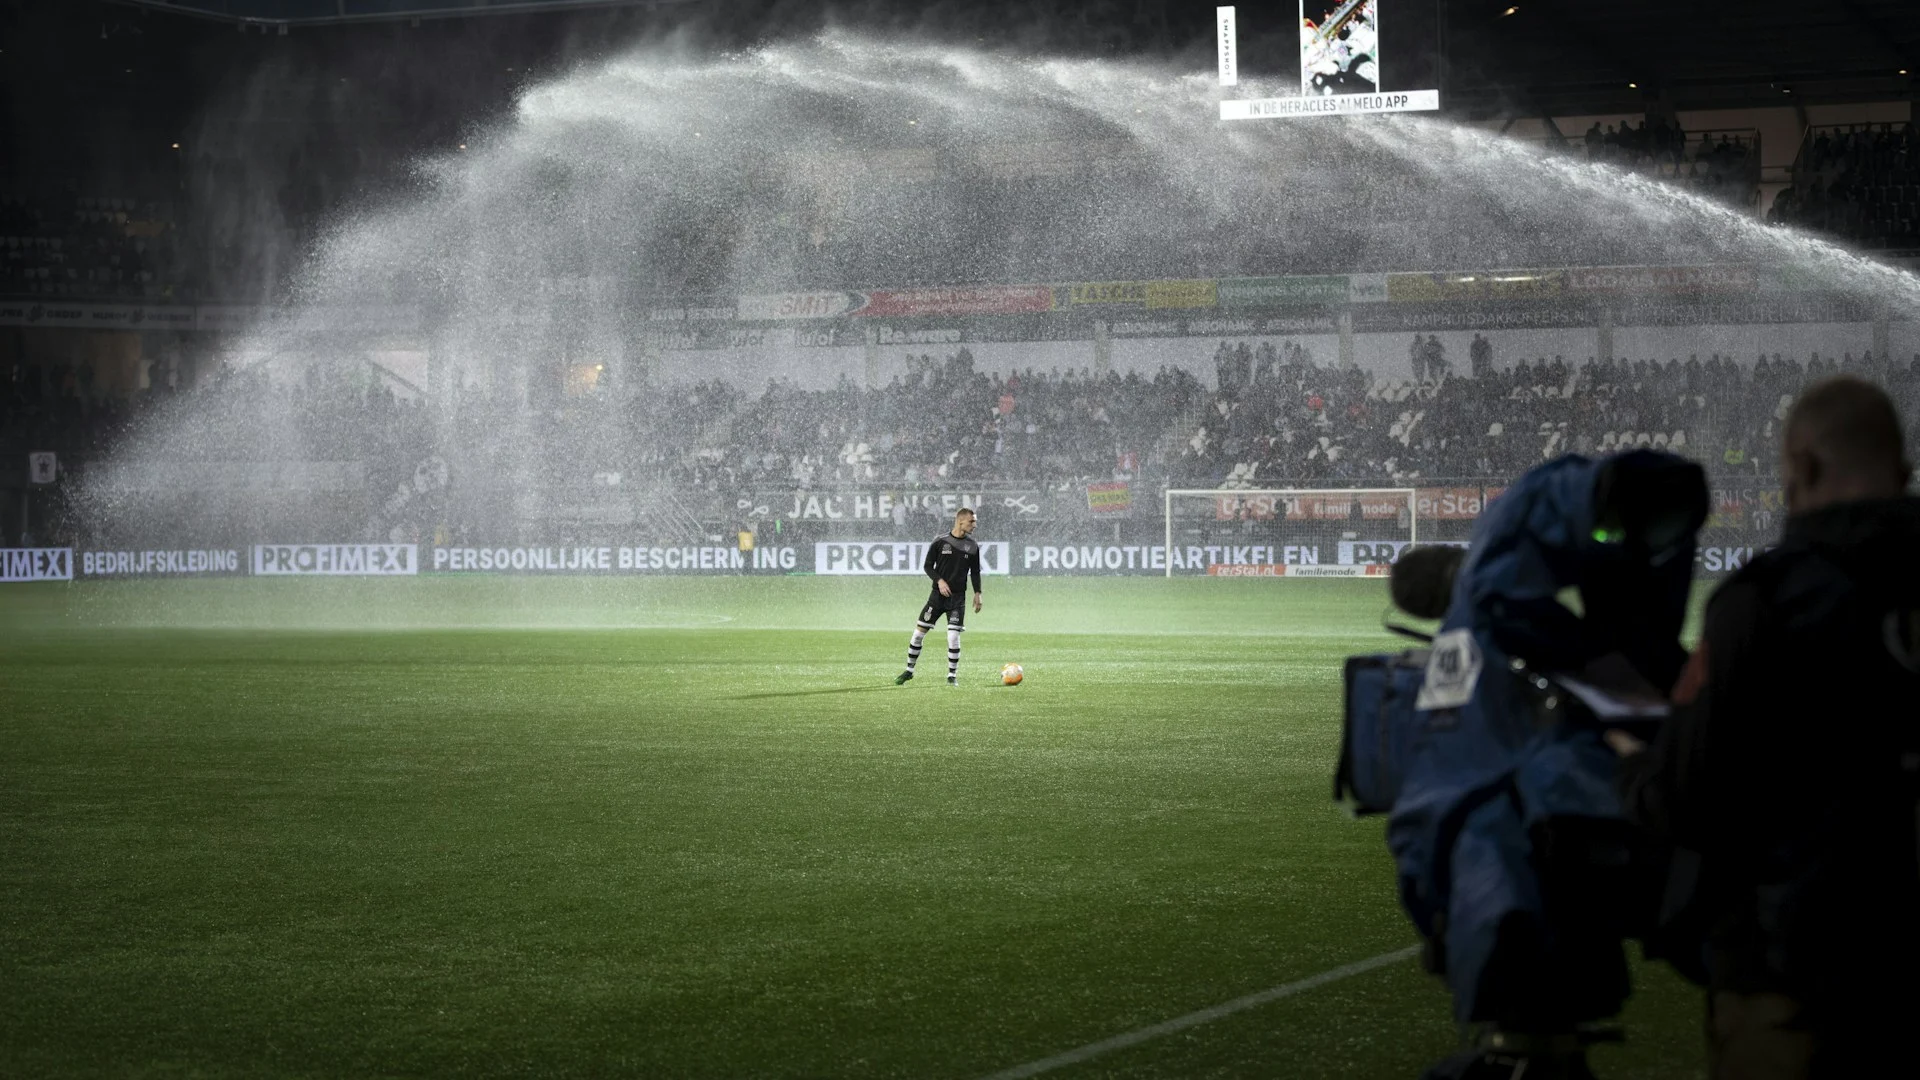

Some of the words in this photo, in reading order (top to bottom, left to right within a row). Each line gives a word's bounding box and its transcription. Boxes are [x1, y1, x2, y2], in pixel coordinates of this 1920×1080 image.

[1250, 103, 1260, 115] IN
[1264, 101, 1277, 114] DE
[1280, 99, 1336, 113] HERACLES
[1386, 95, 1408, 108] APP
[788, 495, 842, 519] JAC
[83, 550, 237, 575] BEDRIJFSKLEDING
[262, 547, 408, 571] PROFIMEX
[434, 547, 610, 570] PERSOONLIJKE
[618, 547, 796, 570] BESCHERMING
[1216, 565, 1276, 576] terStal.nl
[1294, 567, 1356, 576] familiemode
